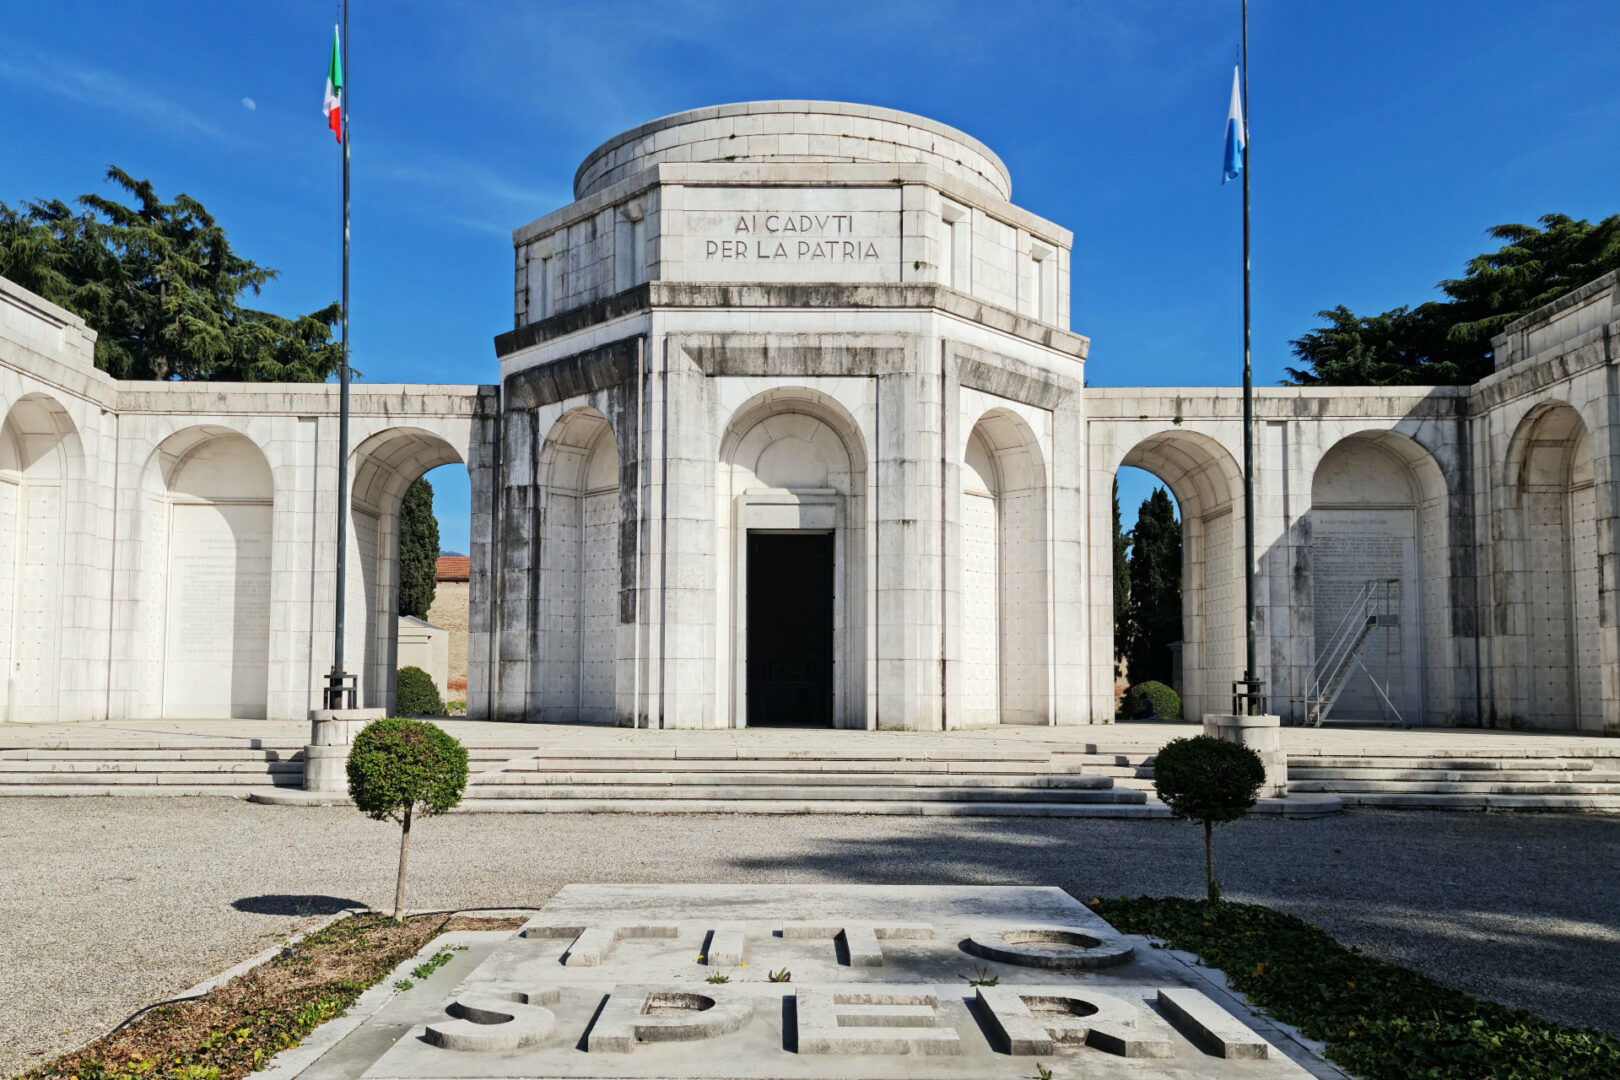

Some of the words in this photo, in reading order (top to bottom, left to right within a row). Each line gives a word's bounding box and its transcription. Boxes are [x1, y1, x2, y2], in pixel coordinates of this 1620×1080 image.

[735, 215, 756, 233] AI
[706, 240, 748, 259] PER
[757, 240, 788, 259] LA
[798, 240, 880, 259] PATRIA
[521, 919, 1135, 969] TITO
[423, 983, 1269, 1060] SPERI
